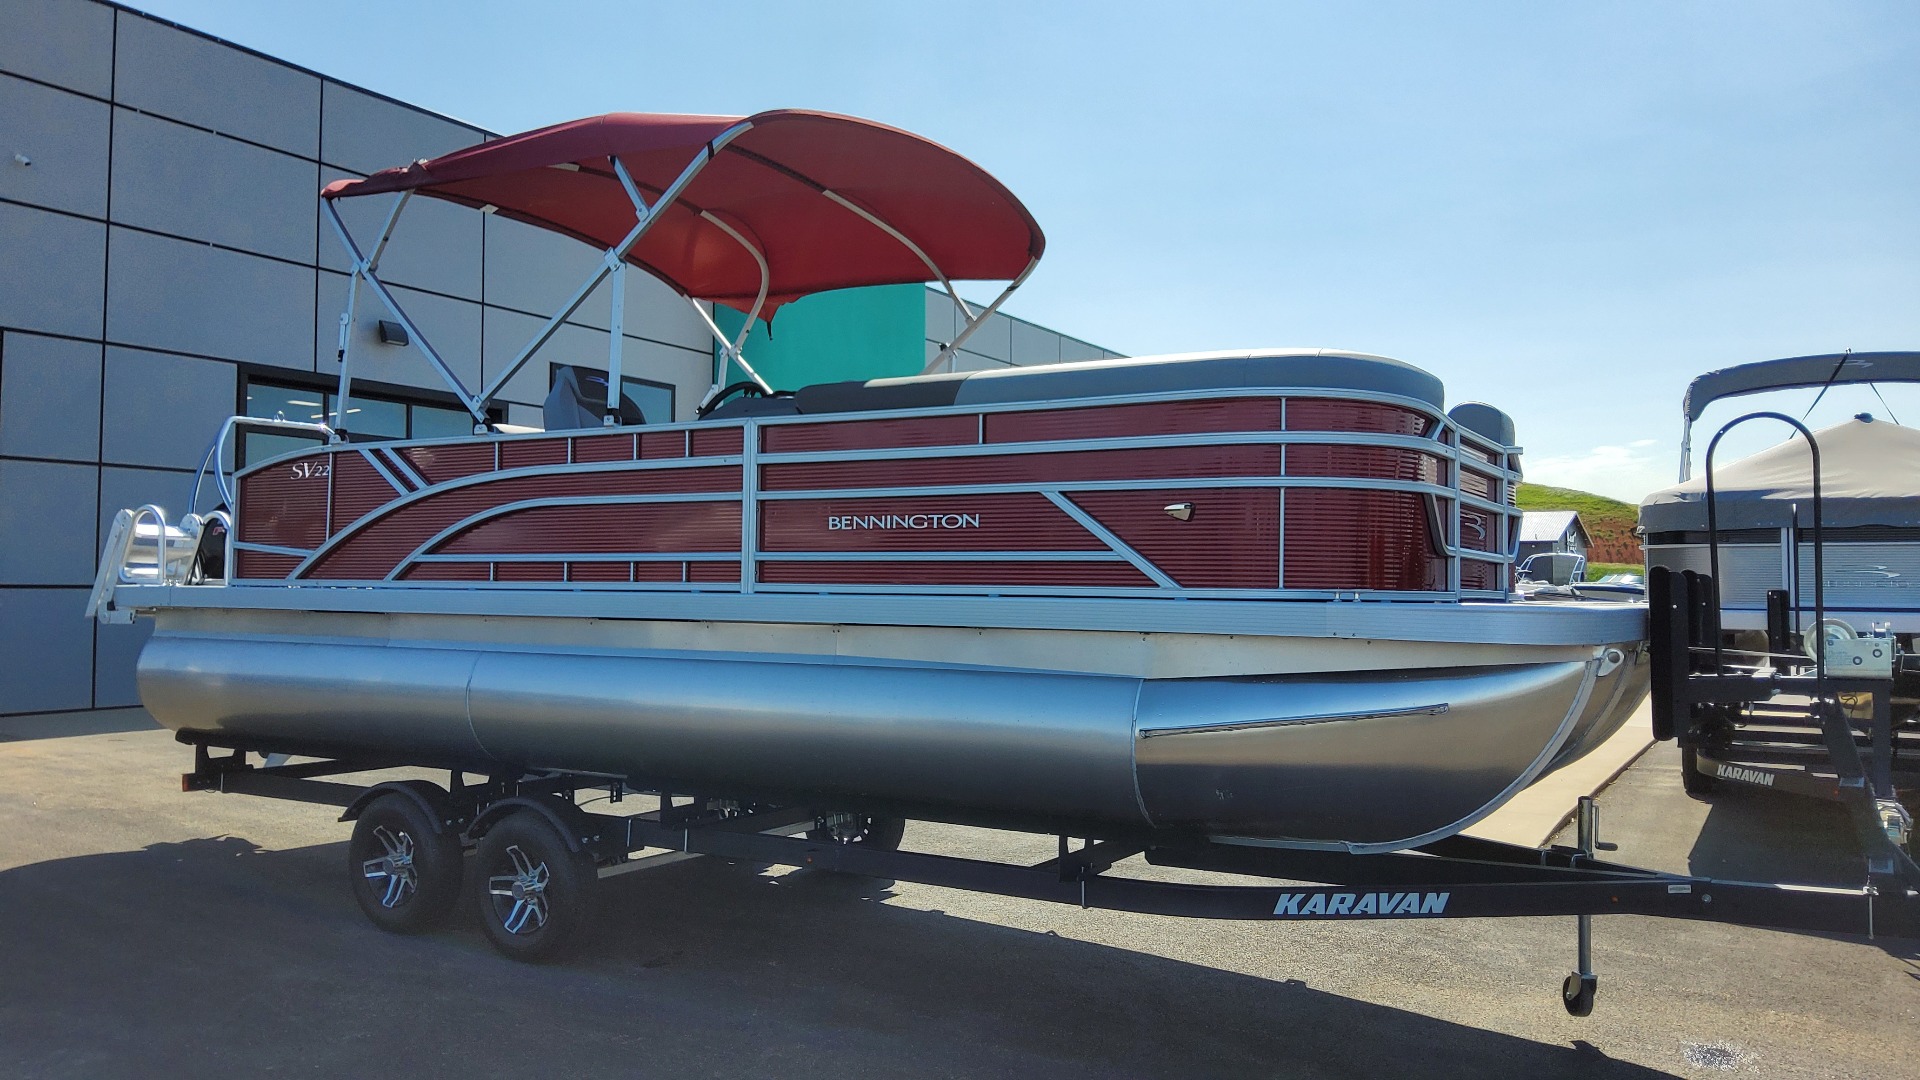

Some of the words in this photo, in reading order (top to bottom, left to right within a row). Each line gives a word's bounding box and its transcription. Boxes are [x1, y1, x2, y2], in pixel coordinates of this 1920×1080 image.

[290, 461, 330, 480] SV22
[828, 513, 980, 530] BENNINGTON
[1716, 764, 1775, 787] KARAVAN
[1273, 892, 1450, 915] KARAVAN
